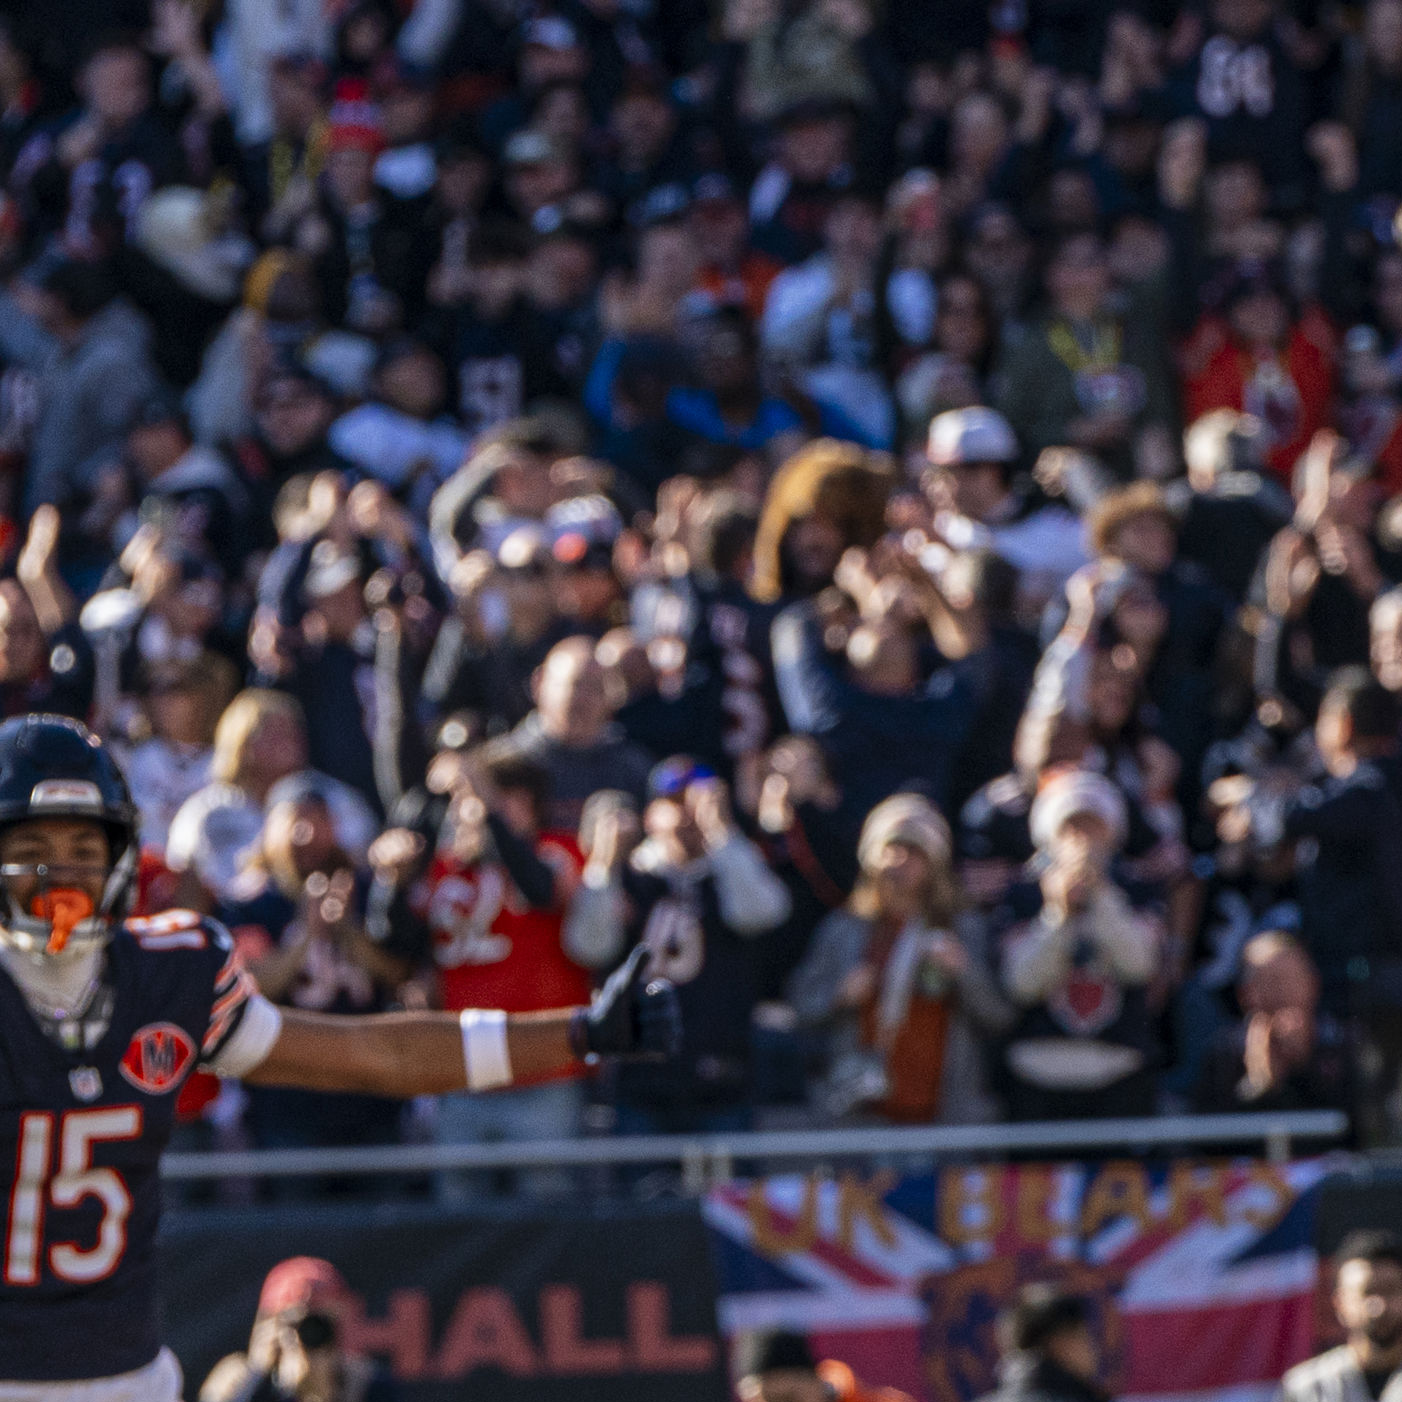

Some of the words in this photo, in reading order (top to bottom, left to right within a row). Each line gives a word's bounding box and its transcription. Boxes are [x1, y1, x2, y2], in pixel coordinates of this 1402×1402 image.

[3, 1105, 143, 1287] 15
[748, 1166, 904, 1258] UK
[938, 1158, 1290, 1246] BEARS
[338, 1277, 716, 1380] HALL
